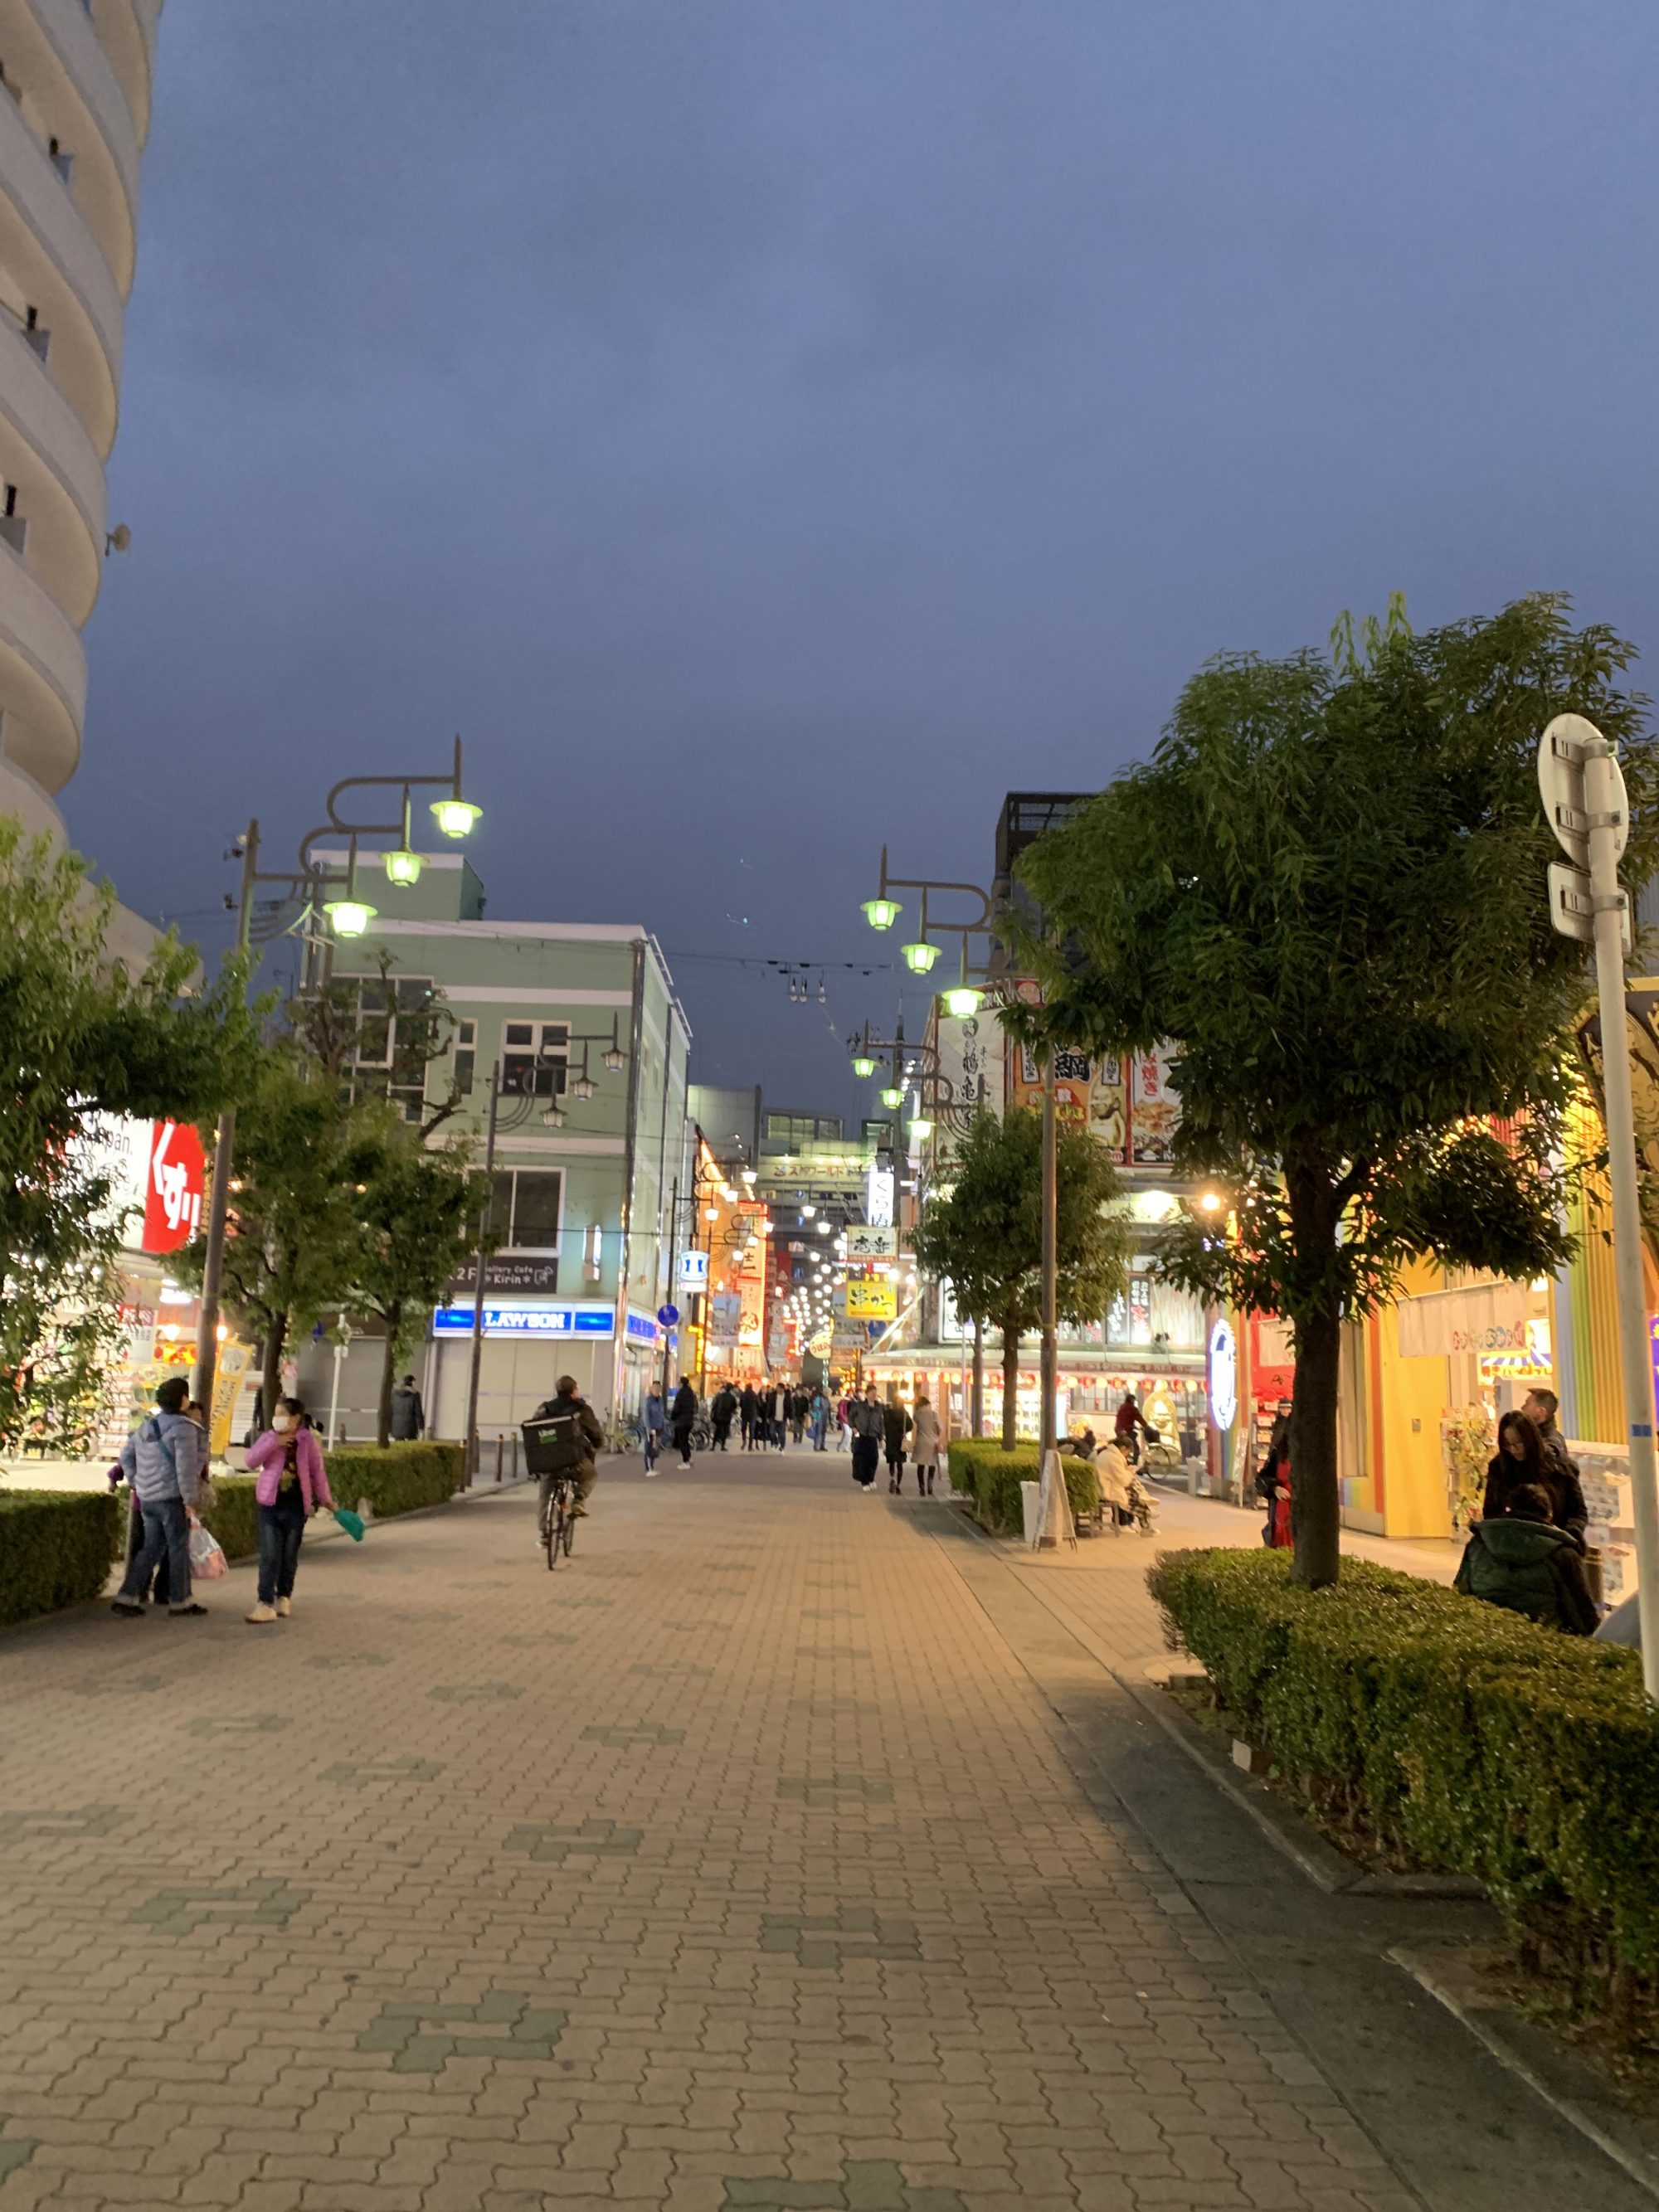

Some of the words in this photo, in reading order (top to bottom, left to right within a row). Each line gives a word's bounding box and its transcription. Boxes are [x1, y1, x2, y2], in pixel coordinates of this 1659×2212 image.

[457, 1267, 477, 1280] 2F
[485, 1265, 511, 1274] allery
[494, 1273, 521, 1284] Kirin
[849, 1283, 893, 1310] 串かつ
[484, 1312, 565, 1329] LAWSON
